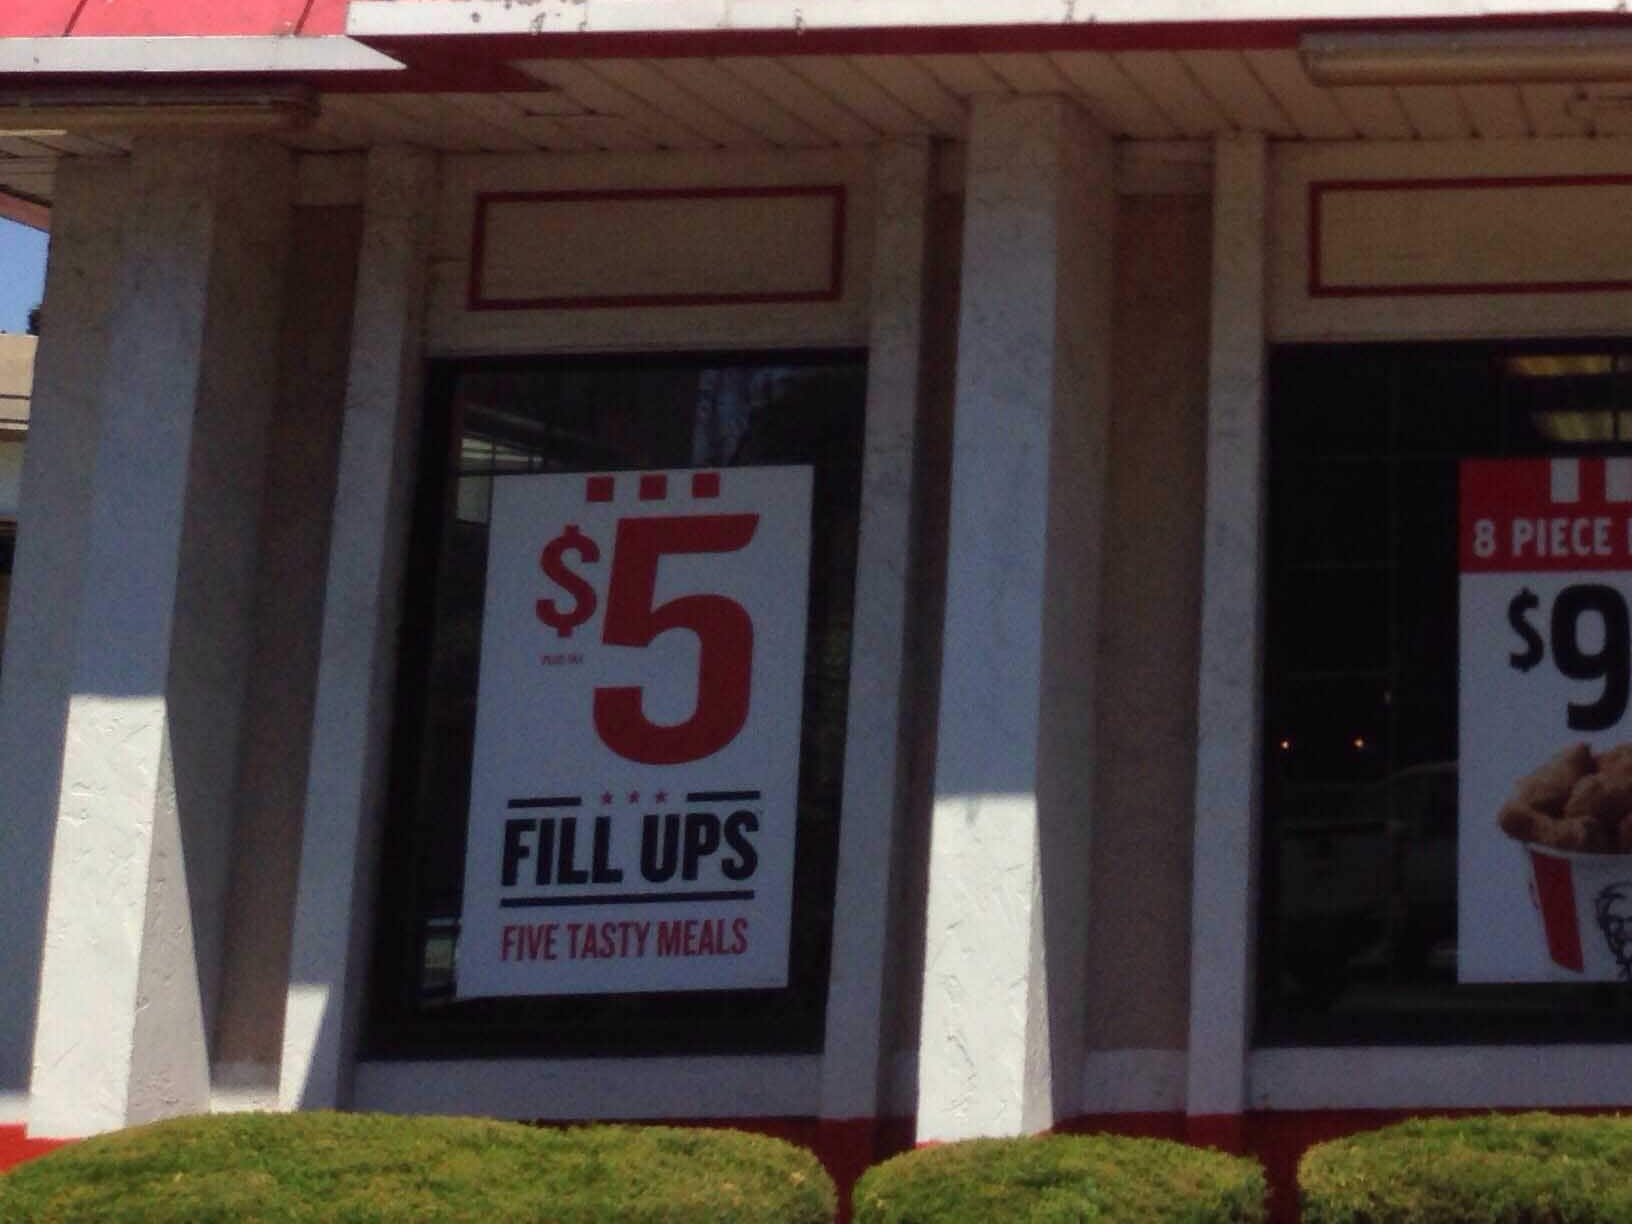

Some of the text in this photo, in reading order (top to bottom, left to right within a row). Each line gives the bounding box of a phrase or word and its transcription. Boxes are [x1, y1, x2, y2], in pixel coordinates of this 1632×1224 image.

[1472, 518, 1497, 558] 8
[1511, 515, 1614, 557] PIECE
[535, 513, 760, 766] $5
[501, 810, 760, 886] FILL UPS
[501, 917, 749, 961] FIVE TASTY MEALS
